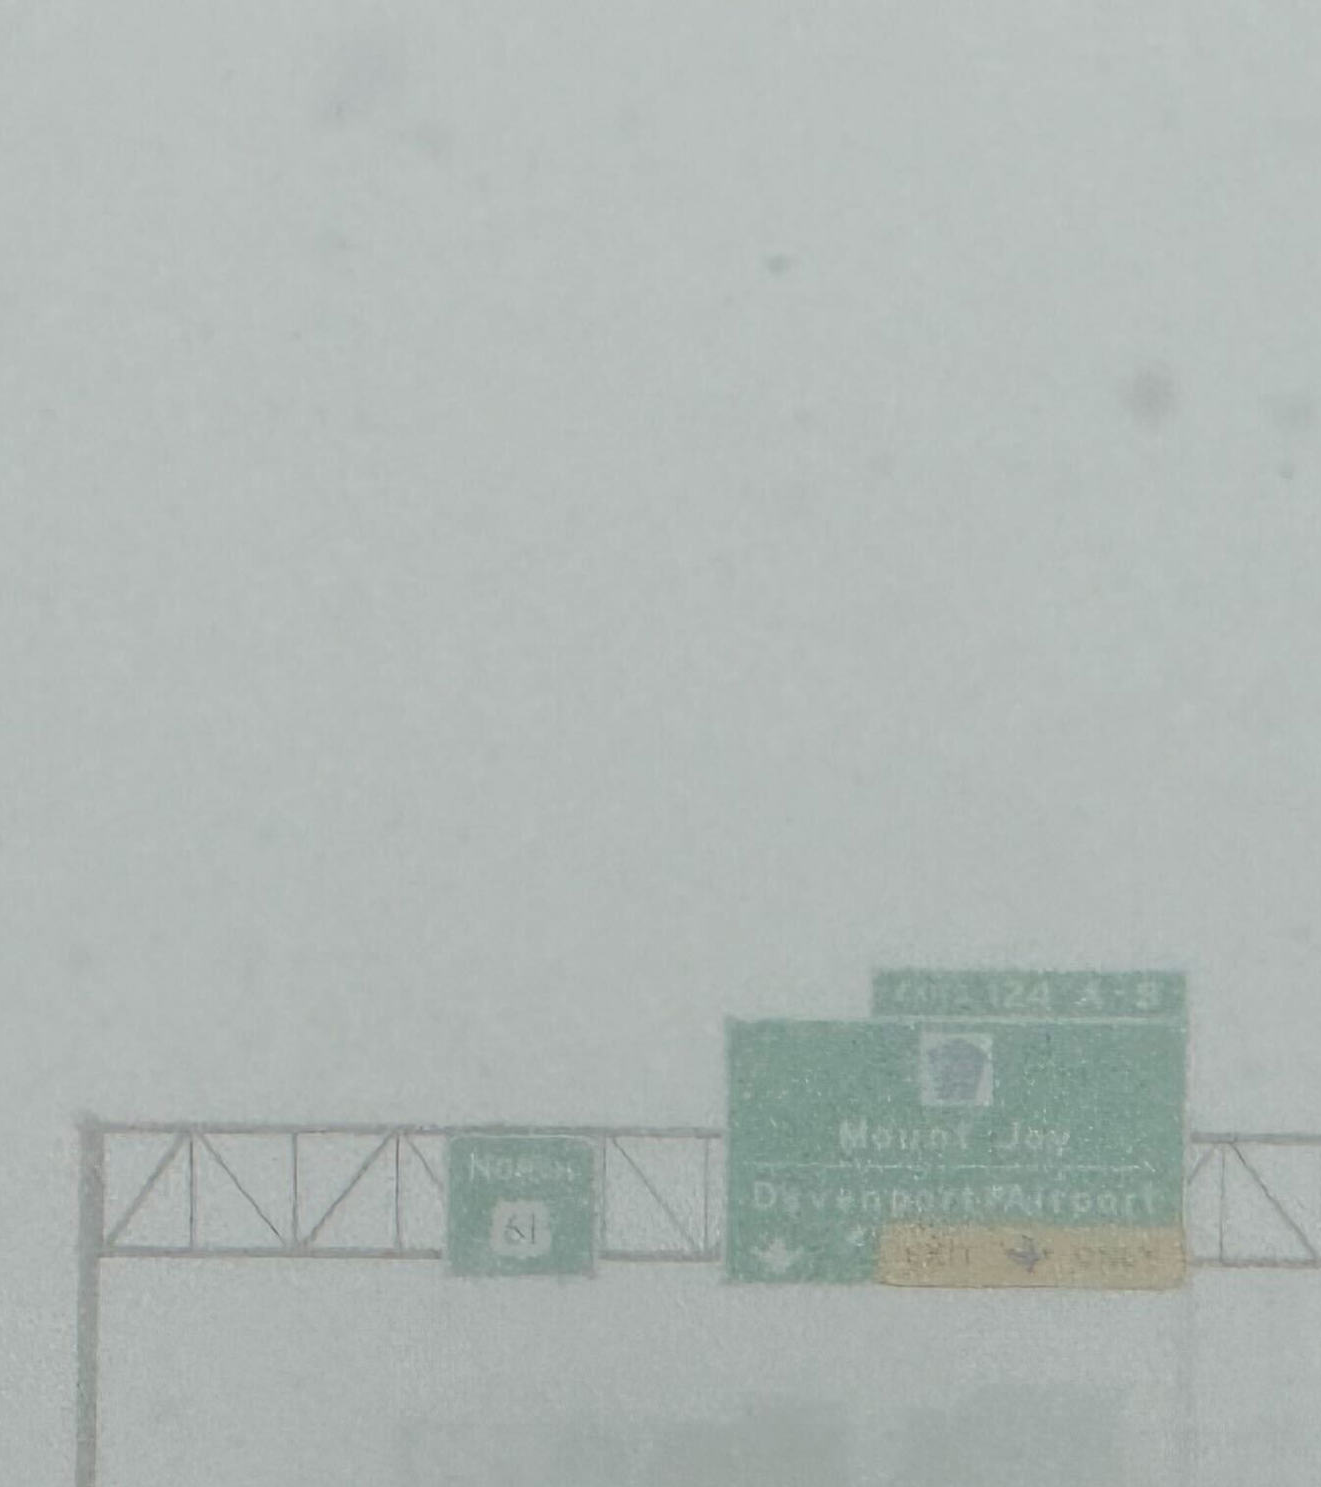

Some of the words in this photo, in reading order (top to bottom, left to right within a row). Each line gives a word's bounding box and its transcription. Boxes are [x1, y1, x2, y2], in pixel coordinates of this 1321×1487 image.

[987, 980, 1051, 1009] 124
[838, 1119, 971, 1150] Mount
[995, 1120, 1071, 1156] Joy
[752, 1181, 977, 1219] Davenport
[1004, 1181, 1157, 1219] Airport
[503, 1213, 537, 1246] 61
[904, 1243, 971, 1267] EXIT
